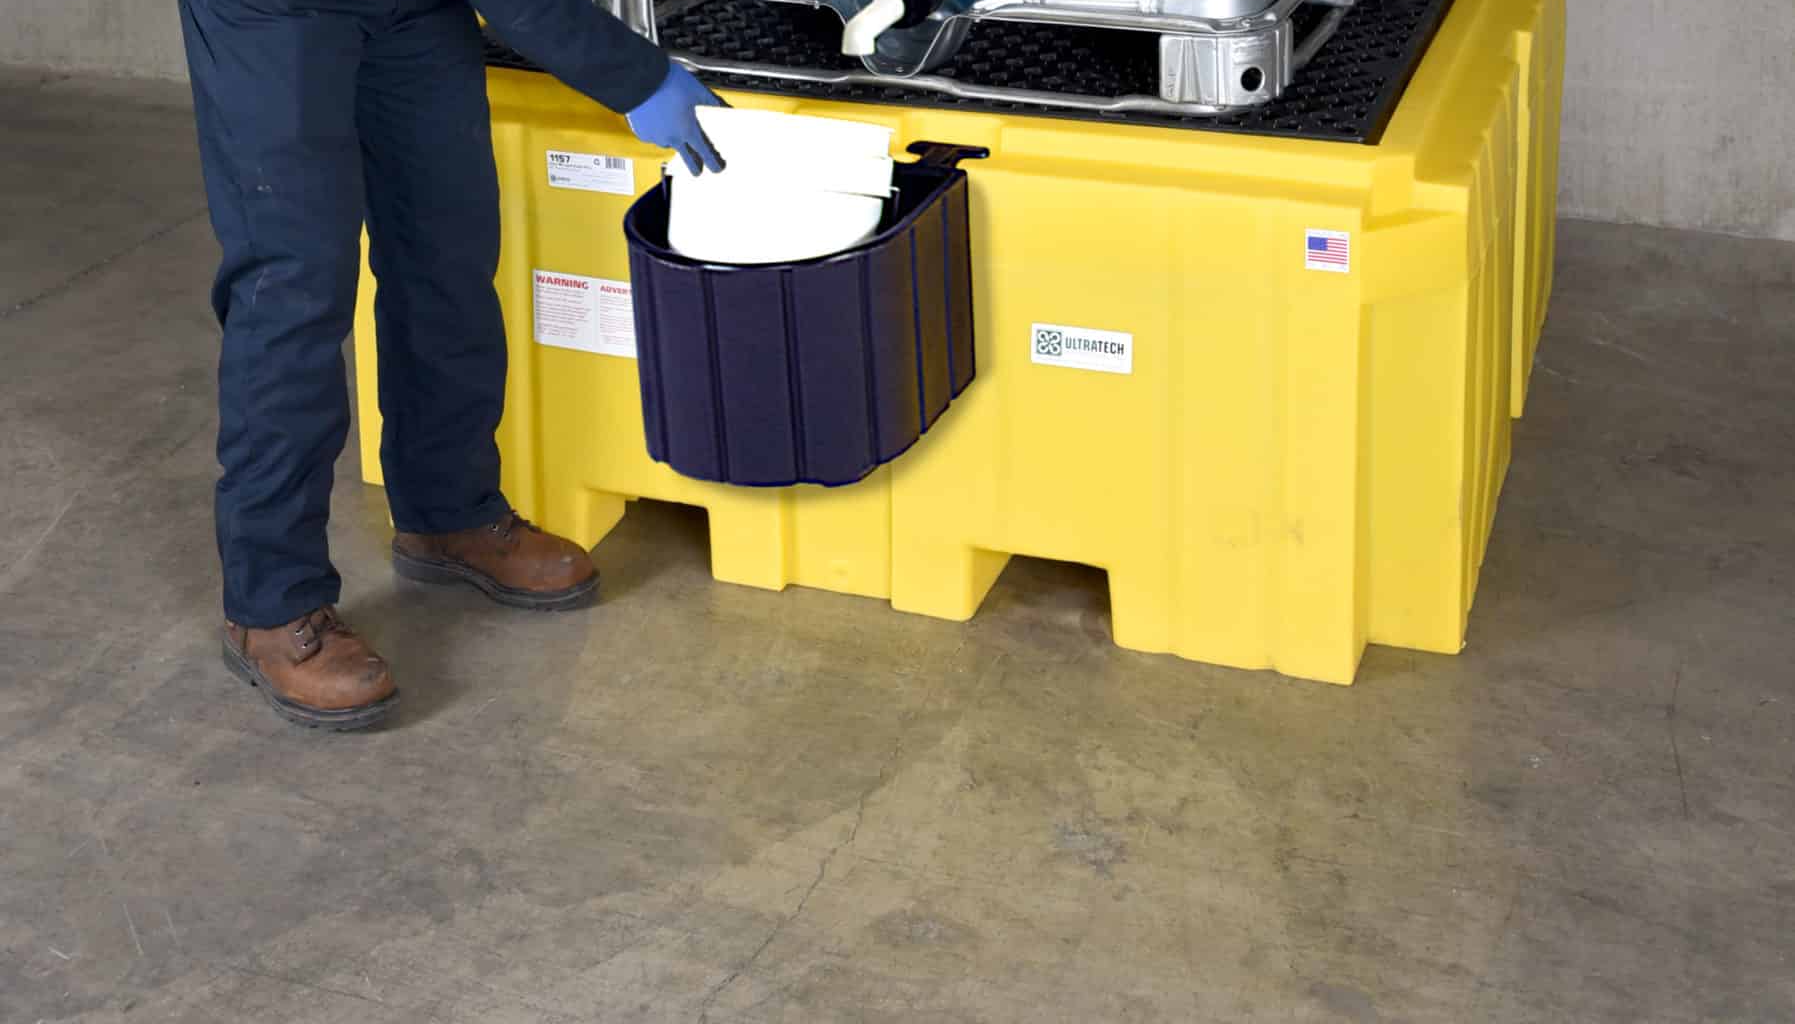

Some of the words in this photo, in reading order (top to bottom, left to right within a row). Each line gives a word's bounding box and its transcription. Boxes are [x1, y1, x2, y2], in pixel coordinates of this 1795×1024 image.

[550, 154, 570, 163] 1157
[535, 274, 589, 290] WARNING
[1065, 336, 1125, 355] ULTRATECH
